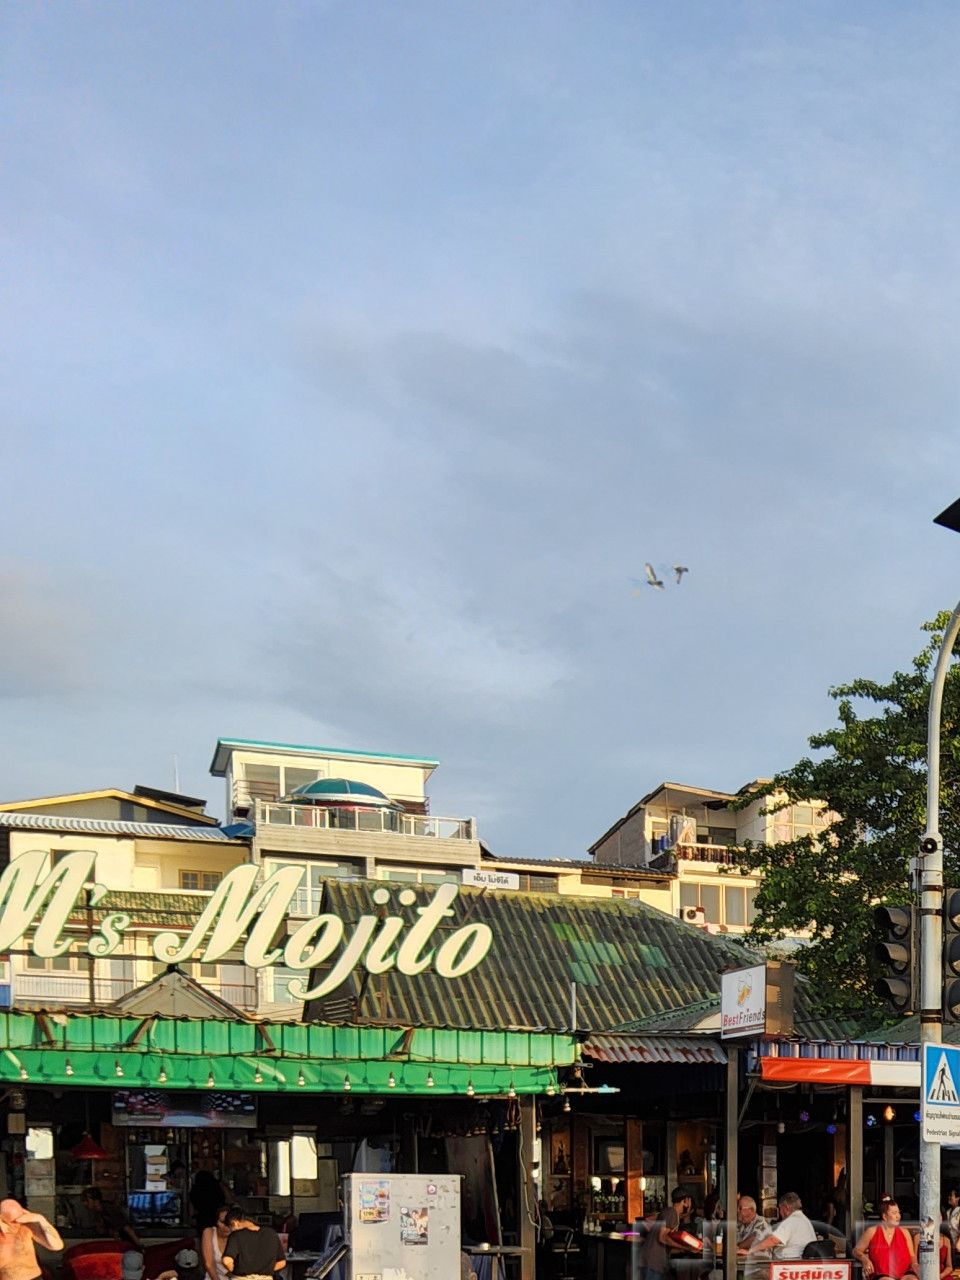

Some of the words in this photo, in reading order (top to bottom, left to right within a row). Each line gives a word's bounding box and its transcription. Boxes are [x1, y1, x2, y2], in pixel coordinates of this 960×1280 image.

[152, 862, 494, 1000] Mojito
[778, 1267, 844, 1280] รับสมัคร
